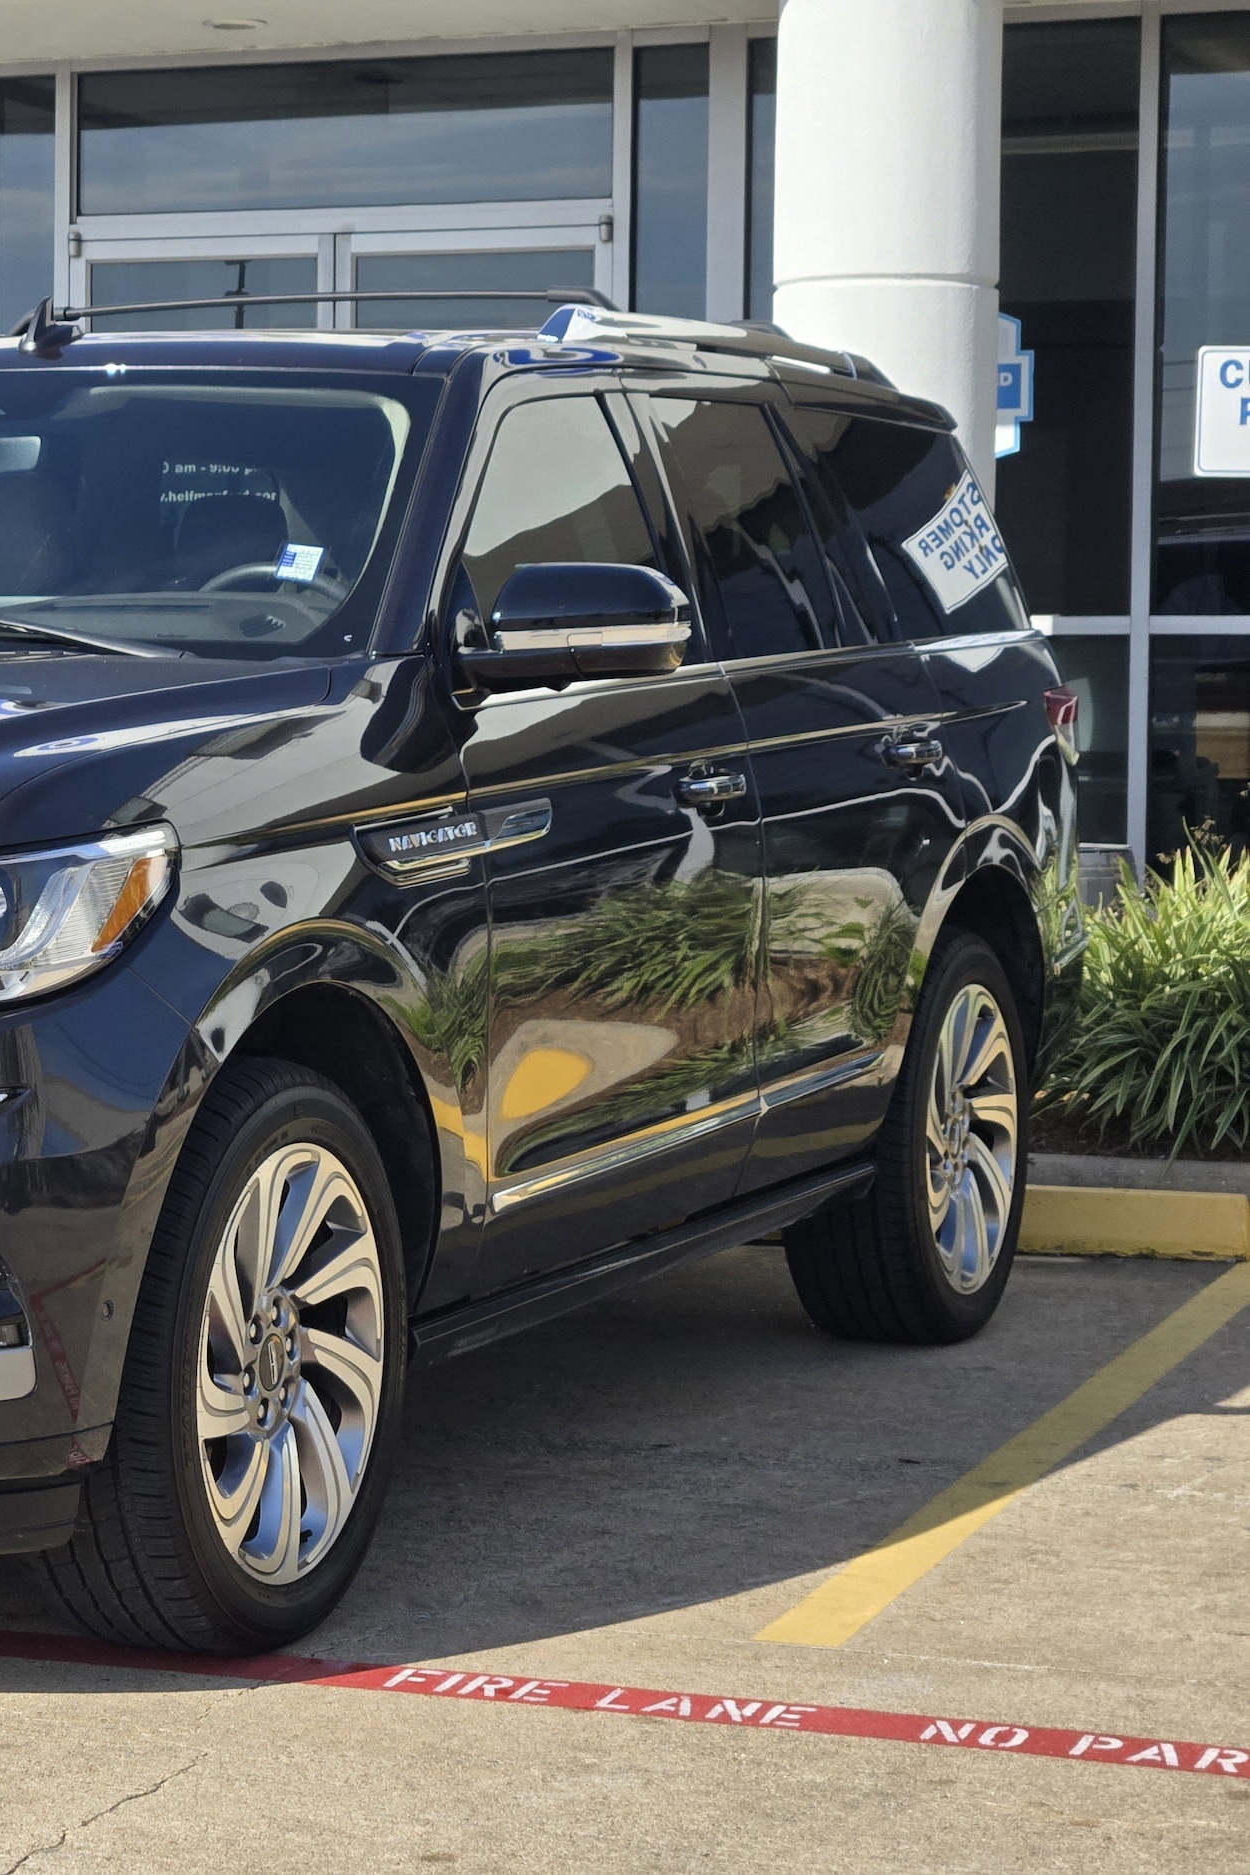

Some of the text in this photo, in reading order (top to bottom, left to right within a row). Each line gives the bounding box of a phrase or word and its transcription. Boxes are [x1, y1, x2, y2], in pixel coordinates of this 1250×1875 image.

[388, 821, 477, 852] NAVIGATOR
[382, 1668, 1250, 1773] FIRE LANE NO PAR
